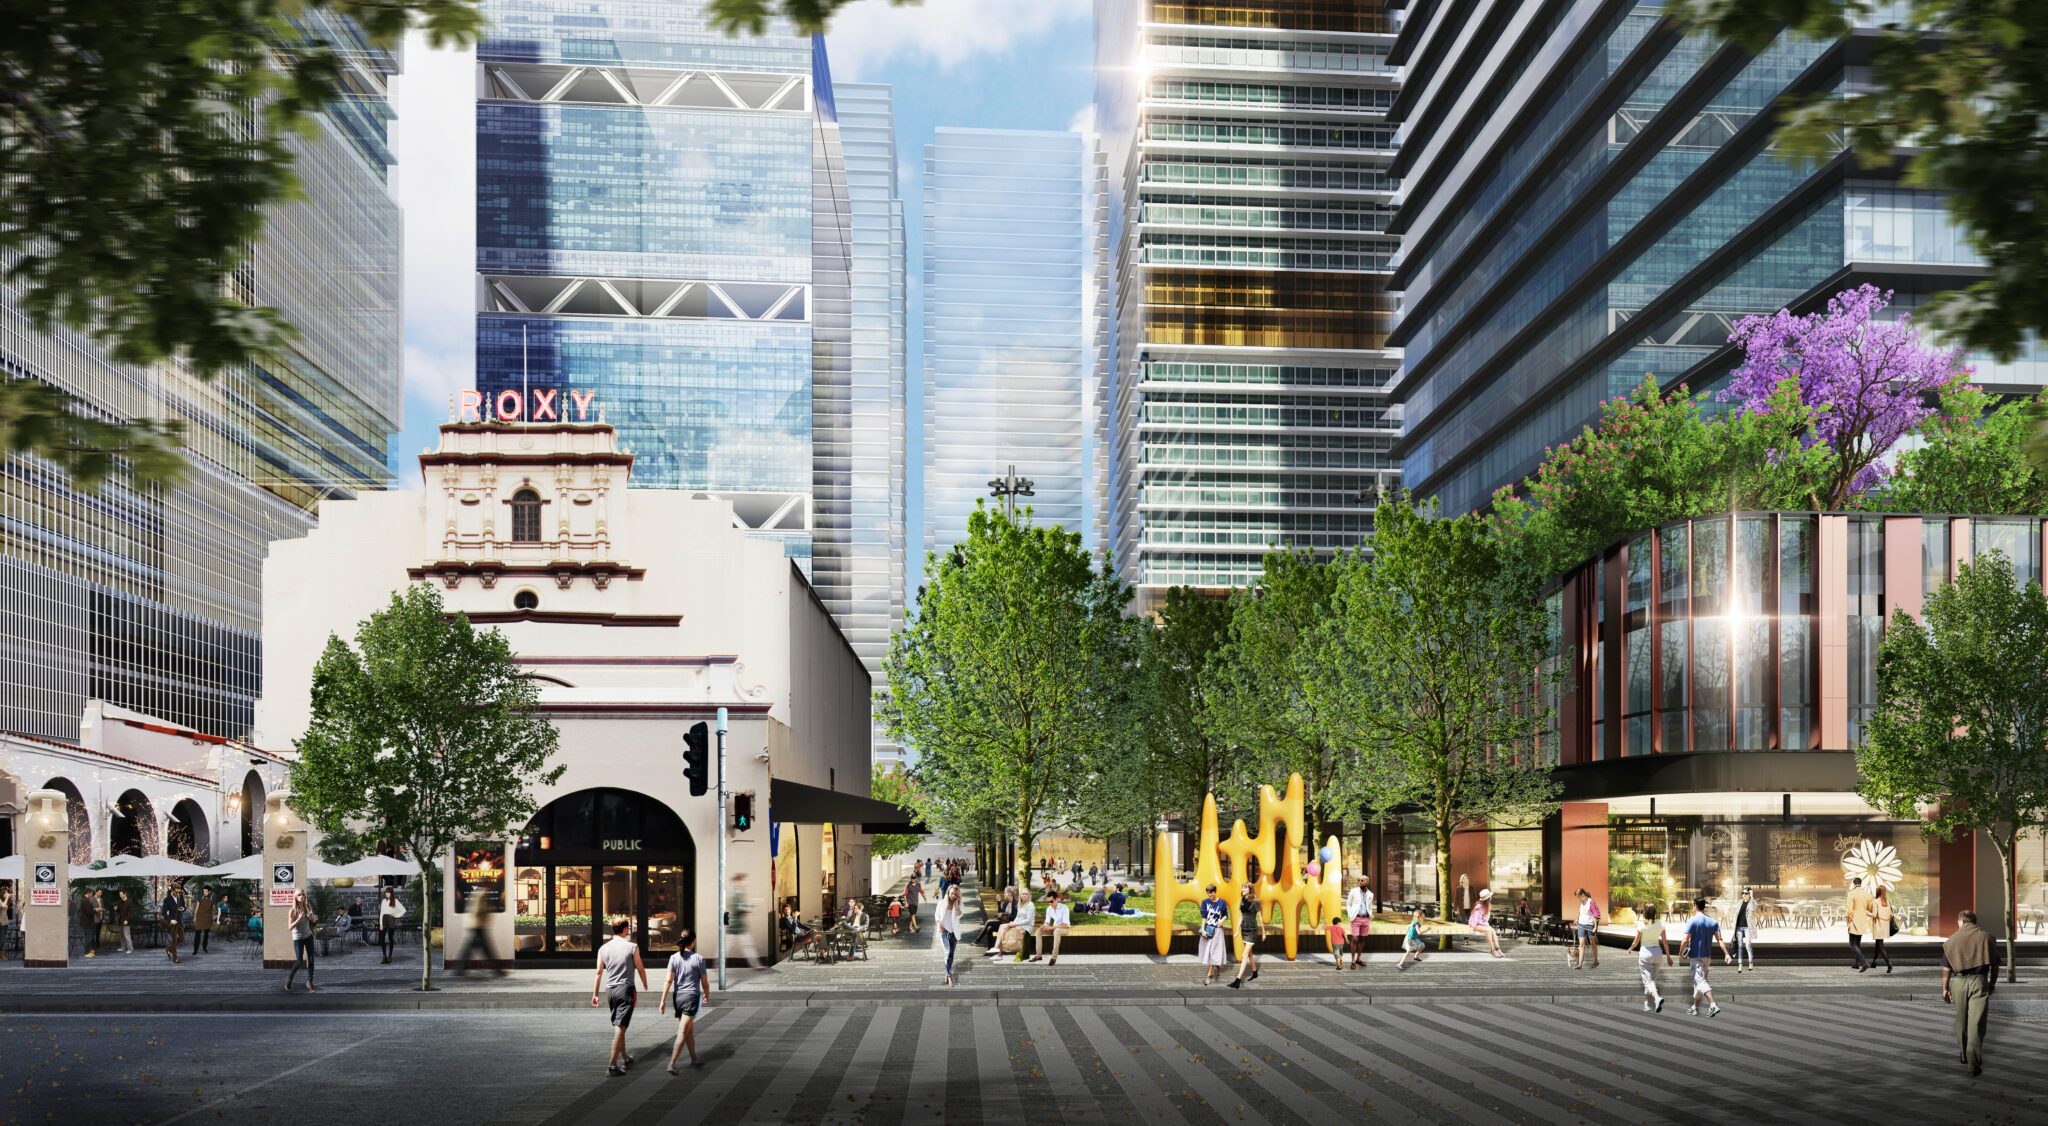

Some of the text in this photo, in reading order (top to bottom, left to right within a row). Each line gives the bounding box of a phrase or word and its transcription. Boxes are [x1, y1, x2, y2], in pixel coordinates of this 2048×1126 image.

[459, 389, 595, 420] ROXY
[603, 839, 642, 850] PUBLIC
[1820, 905, 1848, 918] FLO
